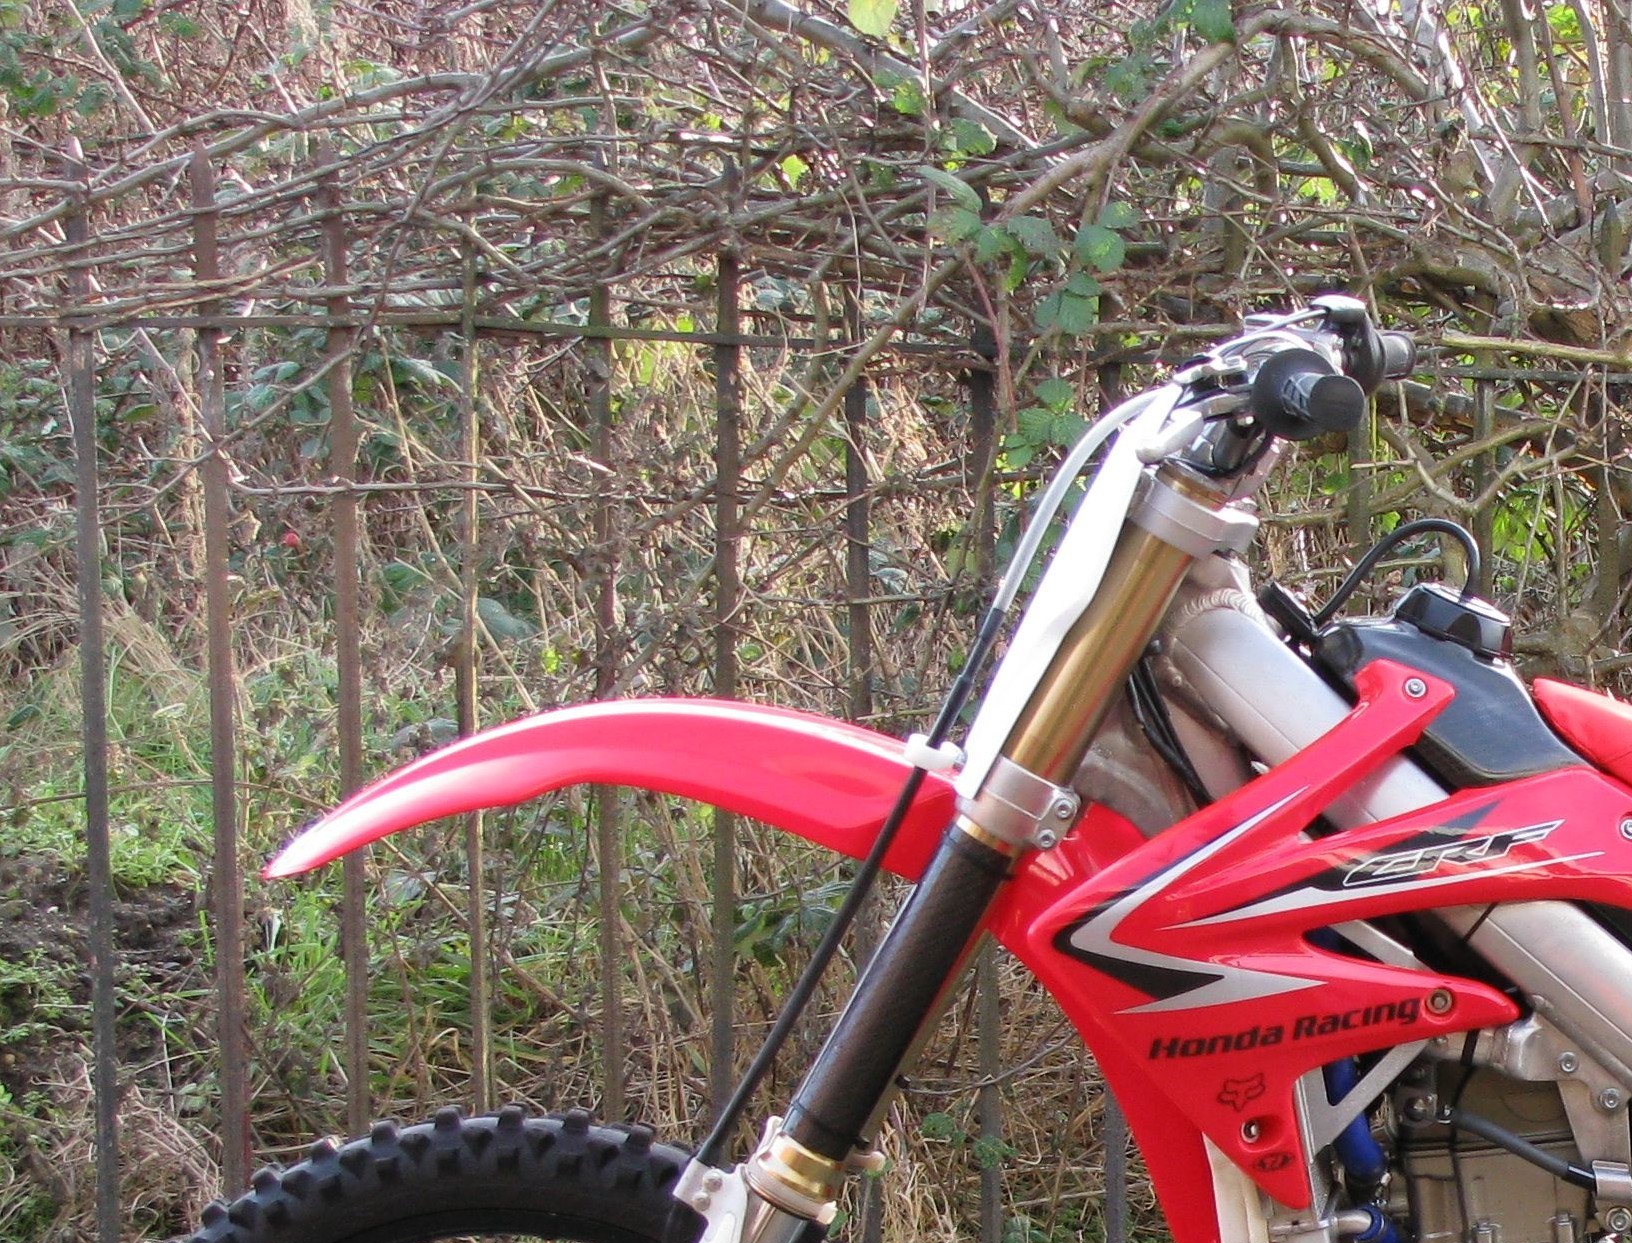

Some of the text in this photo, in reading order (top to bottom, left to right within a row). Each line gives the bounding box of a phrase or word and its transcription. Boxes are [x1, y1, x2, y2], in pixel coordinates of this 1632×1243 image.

[1342, 818, 1566, 887] CRF
[1149, 998, 1421, 1060] Honda Racing
